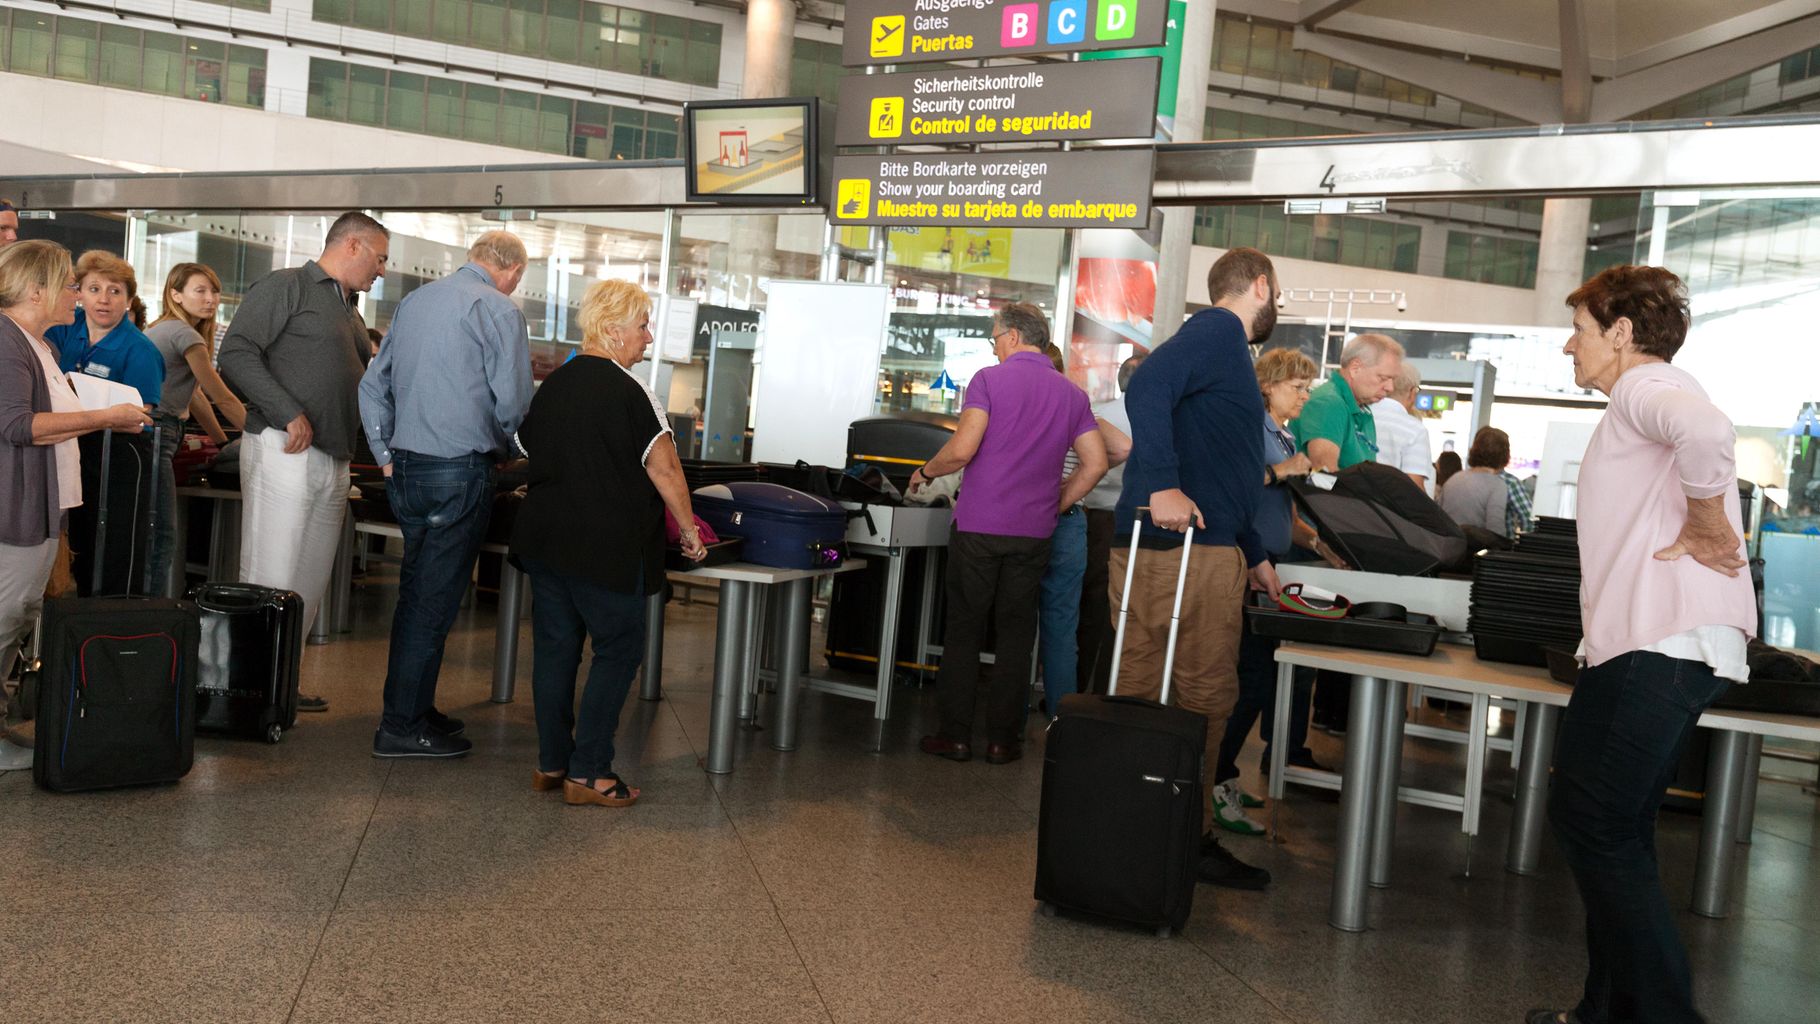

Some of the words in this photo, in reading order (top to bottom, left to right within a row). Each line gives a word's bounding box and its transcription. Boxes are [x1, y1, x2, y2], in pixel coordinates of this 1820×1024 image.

[913, 15, 949, 31] Gates
[1011, 12, 1029, 39] B
[1057, 7, 1077, 35] C
[1106, 3, 1127, 31] D
[911, 34, 974, 53] Puertas
[913, 72, 1044, 94] Sicherheitskontrolle
[912, 96, 965, 115] Security
[968, 93, 1016, 111] control
[910, 115, 971, 135] Control
[975, 114, 997, 133] de
[1001, 110, 1092, 135] seguridad
[879, 161, 909, 177] Bitte
[912, 161, 977, 177] Bordkarte
[981, 160, 1048, 179] vorzeigen
[1320, 165, 1336, 192] 4
[22, 191, 28, 207] 6
[495, 185, 503, 205] 5
[878, 181, 912, 196] Show
[915, 183, 945, 199] your
[948, 180, 1006, 199] boarding
[1010, 180, 1042, 196] card
[877, 199, 938, 217] Muestre
[941, 203, 961, 218] su
[964, 199, 1018, 222] tarjeta
[1021, 200, 1044, 218] de
[1048, 200, 1138, 222] embarque
